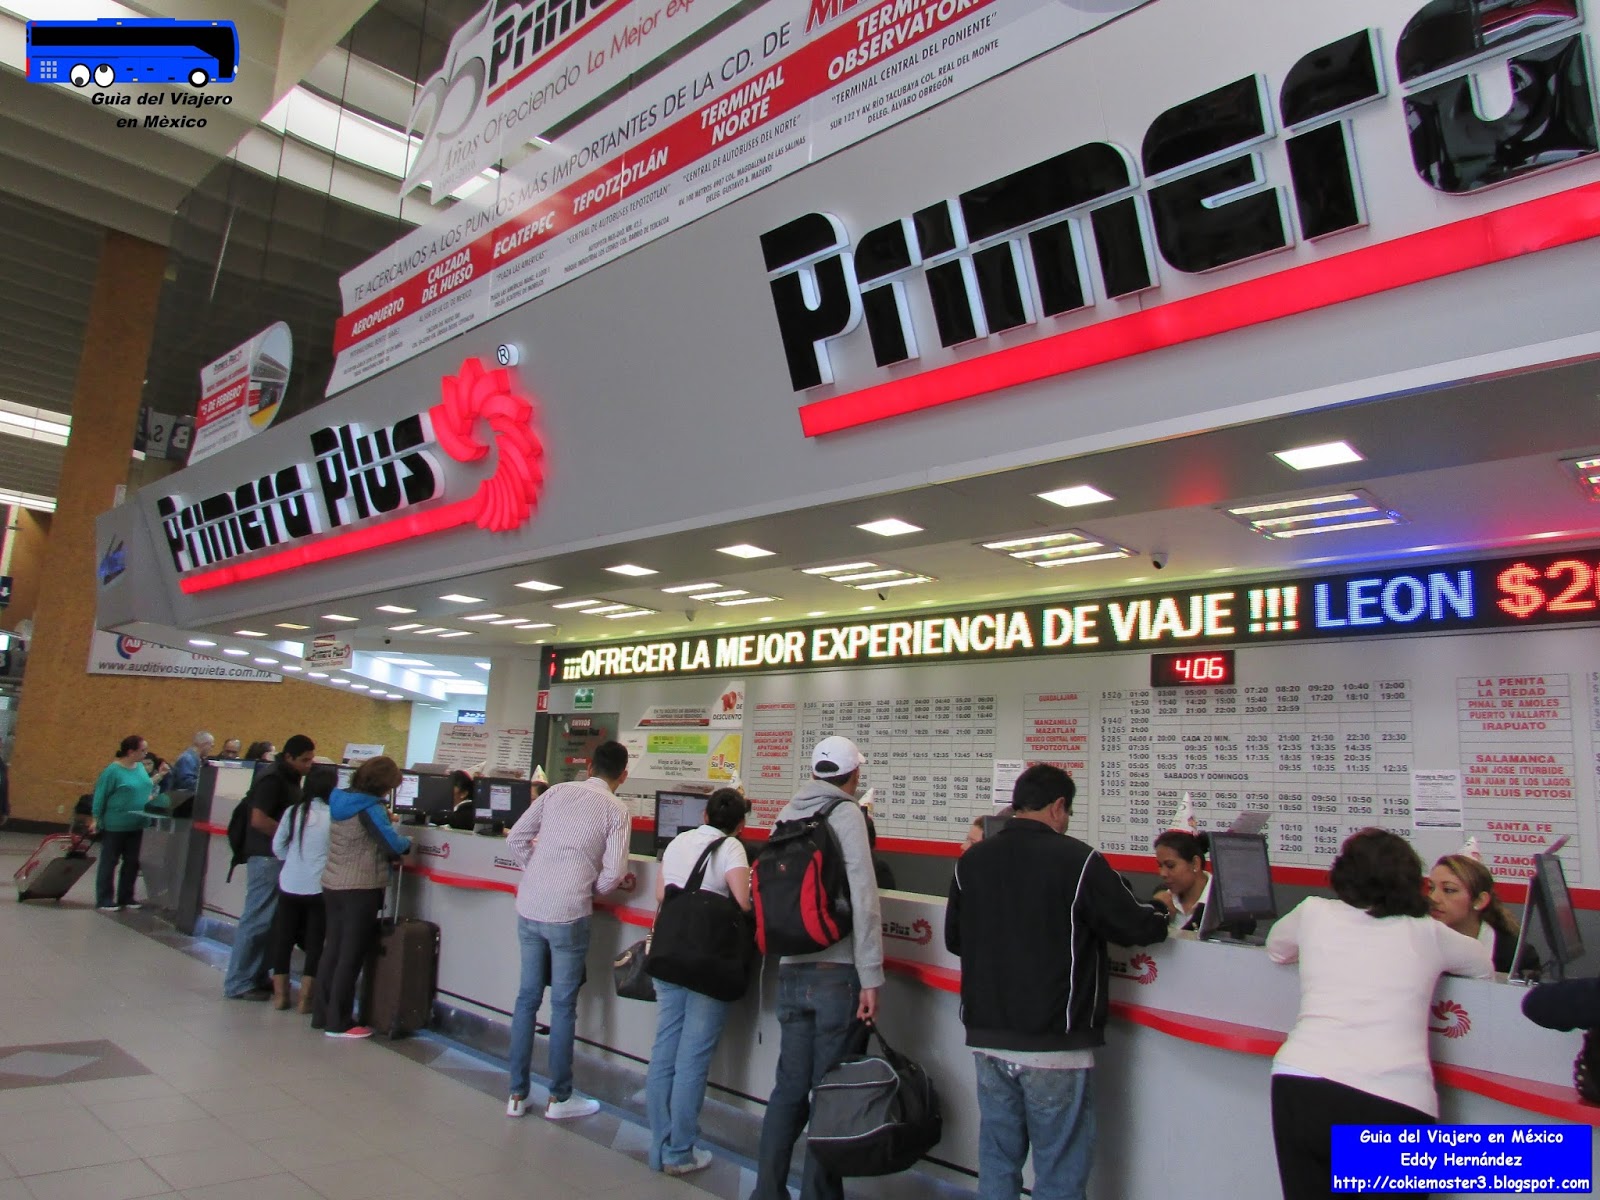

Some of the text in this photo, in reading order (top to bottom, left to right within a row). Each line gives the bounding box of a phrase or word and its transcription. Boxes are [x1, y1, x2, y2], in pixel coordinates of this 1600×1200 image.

[587, 50, 605, 74] La
[610, 10, 661, 58] Mejor
[881, 55, 919, 81] CENTRAL
[922, 44, 939, 61] DEL
[701, 66, 785, 129] TERMINAL
[830, 116, 842, 130] SUR
[844, 111, 855, 124] 122
[862, 103, 871, 114] AV.
[886, 81, 919, 103] TACUBAYA
[938, 65, 955, 78] REAL
[957, 55, 970, 67] DEL
[972, 39, 999, 59] MONTE
[867, 109, 889, 124] DELEG.
[919, 75, 953, 99] OBREGÓN
[712, 96, 770, 146] NORTE
[366, 251, 428, 294] ACERCAMOS
[428, 246, 438, 261] A
[440, 228, 462, 252] LOS
[466, 192, 515, 236] PUNTOS
[552, 105, 657, 184] IMPORTANTES
[664, 86, 687, 119] DE
[693, 72, 714, 100] LA
[721, 49, 754, 82] CD.
[763, 22, 790, 58] DE
[712, 156, 722, 169] DE
[722, 137, 760, 164] AUTOBUSES
[760, 132, 773, 144] DEL
[572, 146, 668, 215] TEPOTZOTLÁN
[758, 0, 1600, 393] Primera
[493, 211, 556, 259] ECATEPEC
[422, 284, 438, 304] DEL
[440, 263, 474, 294] HUESO
[428, 248, 471, 284] CALZADA
[352, 297, 404, 337] AEROPUERTO
[157, 413, 444, 574] Primera Plus
[1314, 570, 1474, 628] LEON
[680, 639, 710, 670] LA
[716, 631, 802, 668] MEJOR
[812, 611, 1033, 662] EXPERIENCIA
[1042, 605, 1099, 647] DE
[1108, 592, 1235, 642] VIAJE
[98, 659, 273, 679] www.auditivosurquieta.com.mx
[1477, 677, 1545, 687] LA PENITA
[1468, 700, 1496, 708] PINAL
[1518, 699, 1559, 707] AMOLES
[1477, 688, 1546, 697] LA PIEDAD
[1469, 710, 1558, 719] PUERTO VALLARTA
[1482, 722, 1546, 730] IRAPUATO
[1469, 766, 1564, 775] SAN JOSE ITURBIDE
[1476, 755, 1555, 764] SALAMANCA
[1466, 788, 1571, 798] SAN LUIS POTOSI
[1484, 777, 1505, 785] JUAN
[1509, 777, 1519, 785] DE
[1523, 778, 1539, 786] LOS
[1542, 778, 1571, 786] LAGOS
[1486, 822, 1553, 832] SANTA FE
[1493, 833, 1546, 844] TOLUCA
